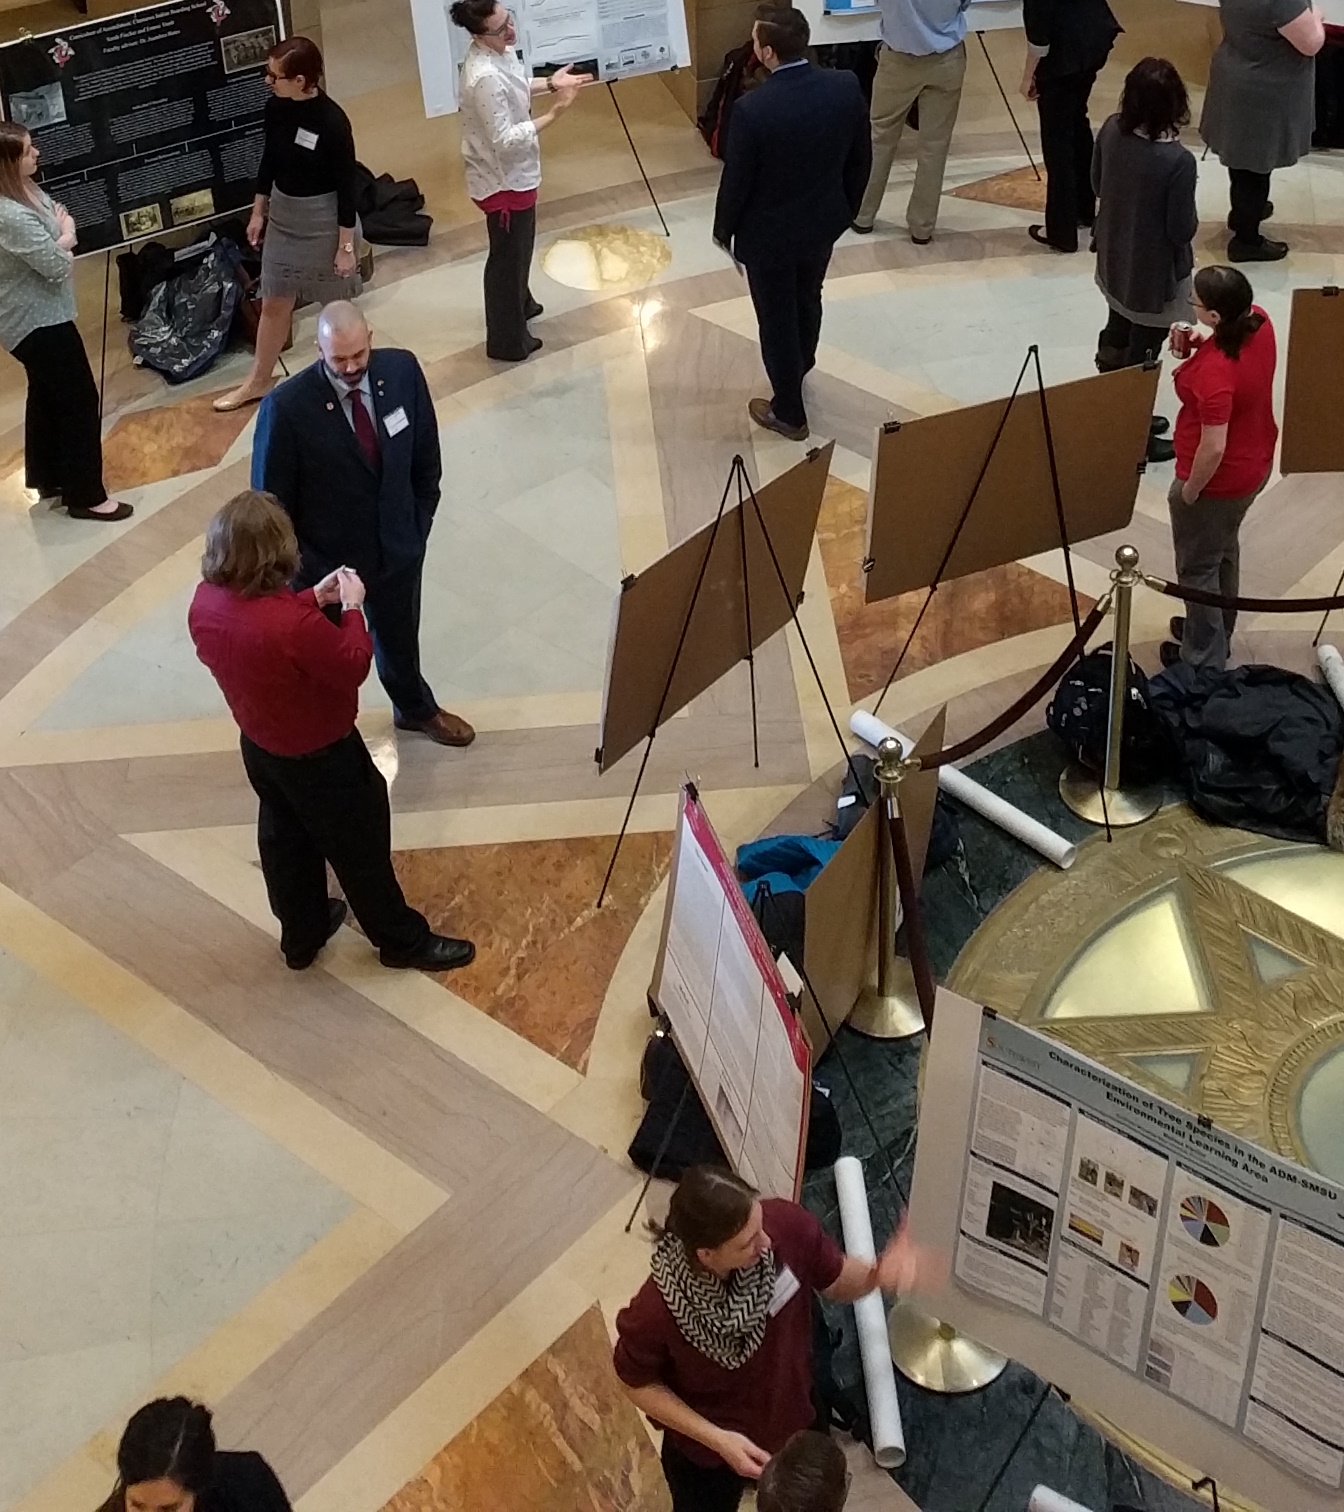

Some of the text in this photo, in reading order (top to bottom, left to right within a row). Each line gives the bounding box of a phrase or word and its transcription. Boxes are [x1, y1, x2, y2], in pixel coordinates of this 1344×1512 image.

[1049, 1051, 1338, 1200] Characterization of Tree Species in the ADM-SMSU
[1106, 1091, 1186, 1138] Environmental
[1189, 1131, 1238, 1168] Learning
[1241, 1163, 1269, 1183] Area
